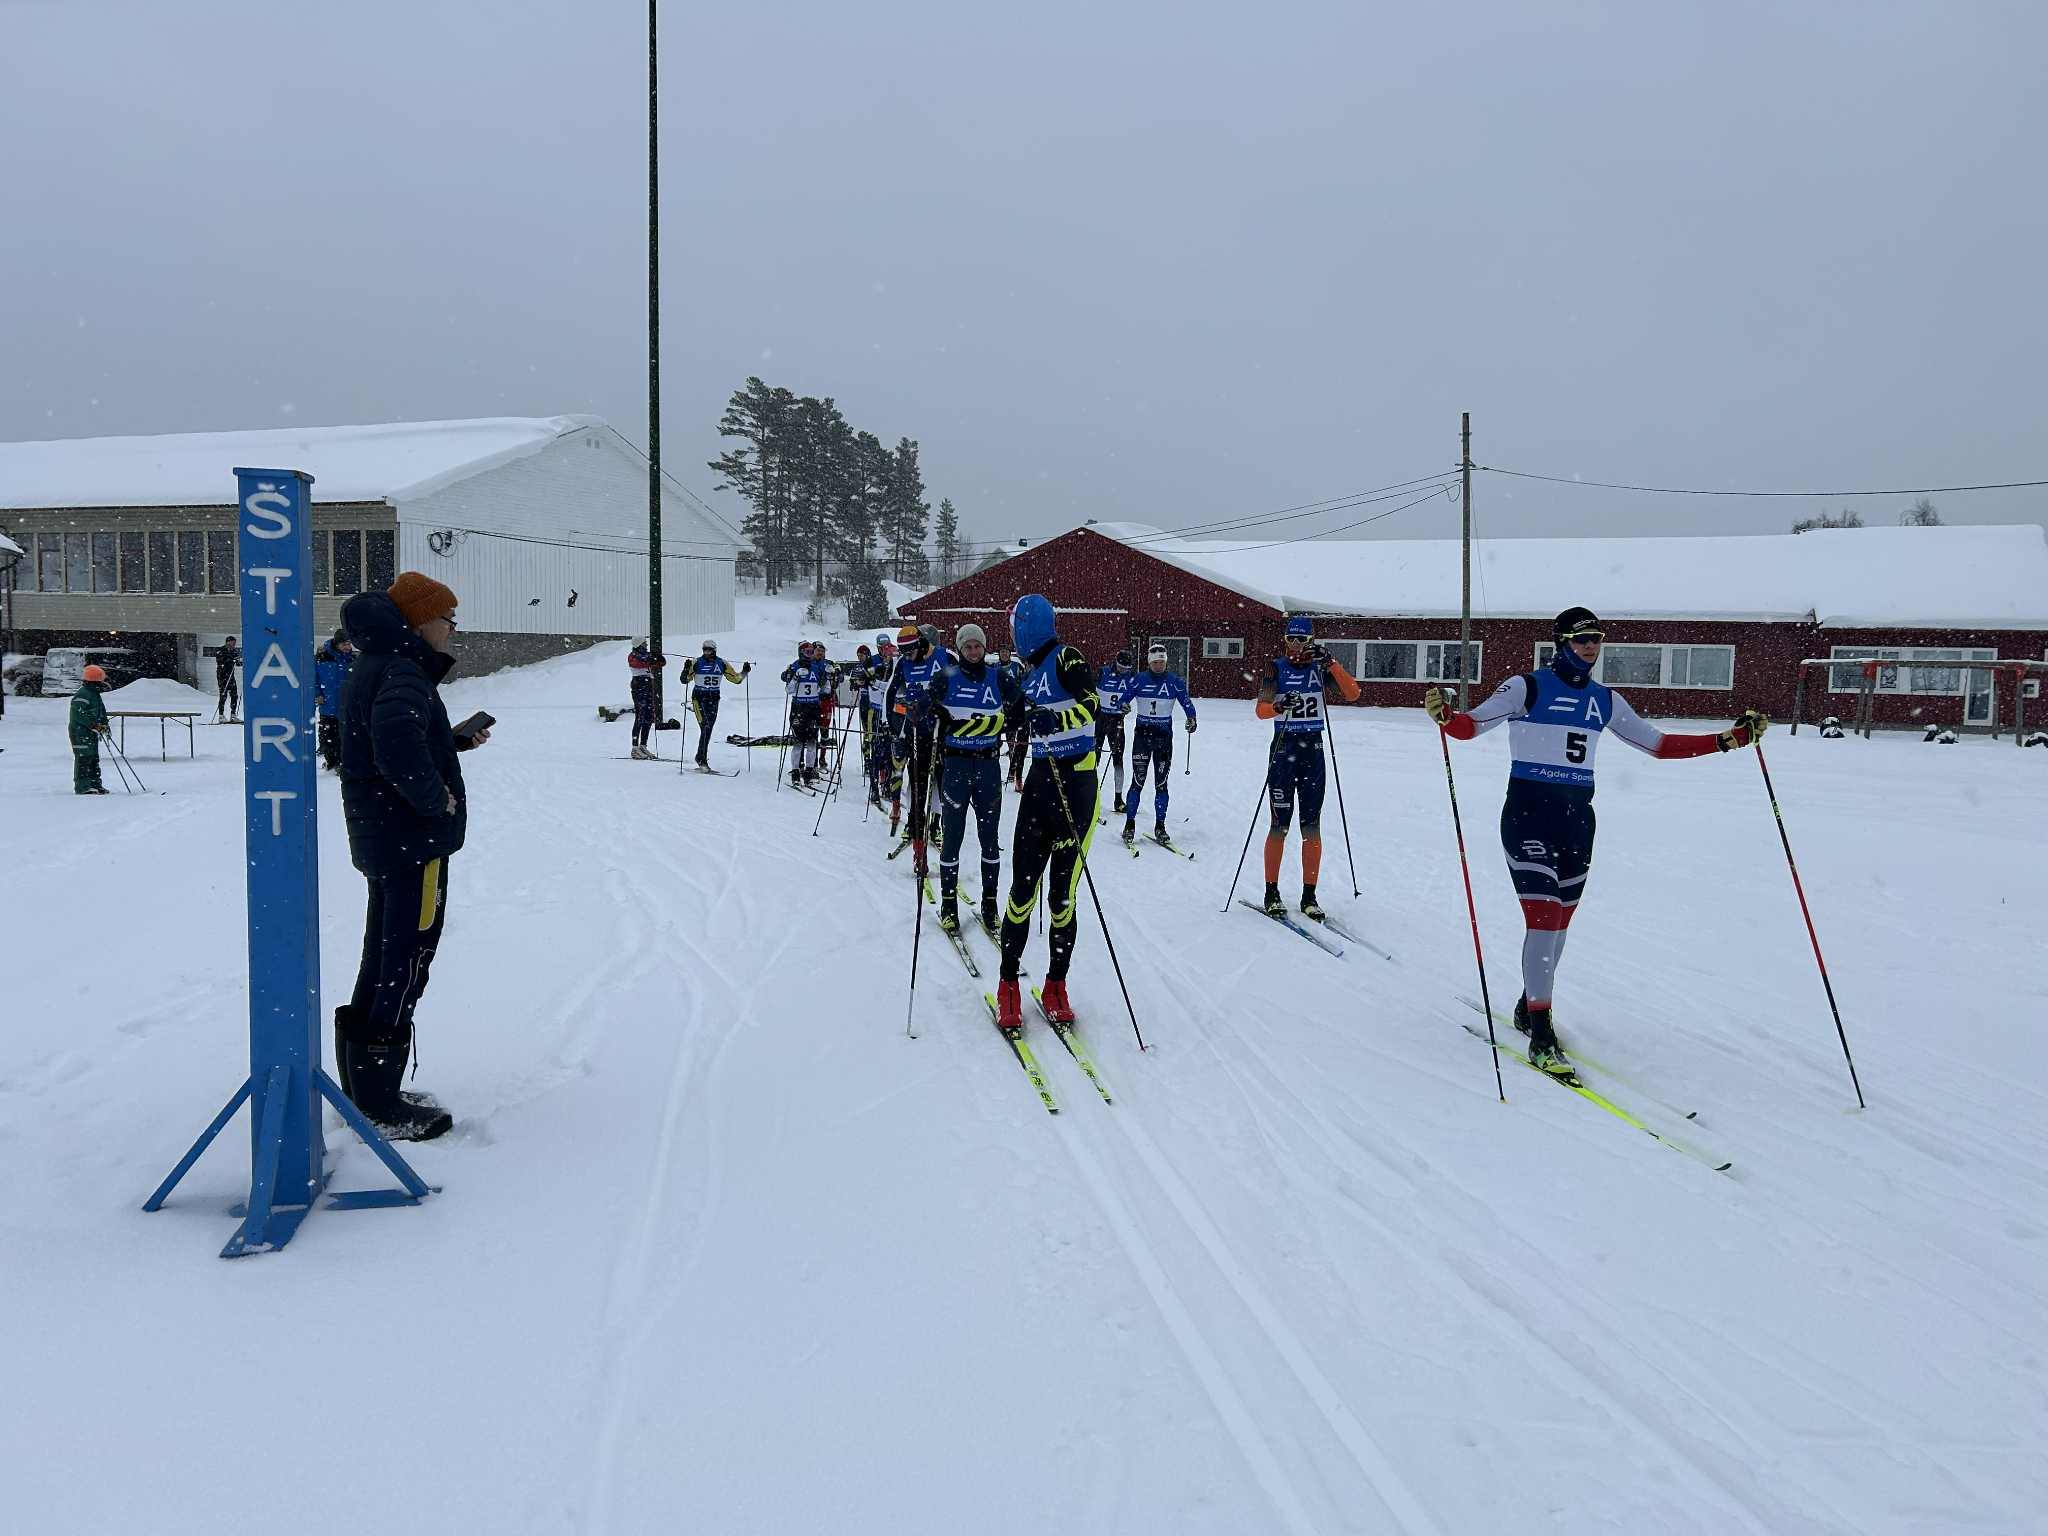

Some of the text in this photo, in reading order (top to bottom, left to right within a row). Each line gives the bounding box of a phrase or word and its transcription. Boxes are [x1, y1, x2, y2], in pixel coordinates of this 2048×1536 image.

[703, 676, 719, 686] 25
[1036, 672, 1052, 698] A
[1118, 680, 1127, 690] A
[1308, 669, 1322, 687] A
[804, 684, 812, 696] 3
[982, 686, 997, 704] A
[1158, 682, 1170, 696] A
[1149, 700, 1157, 715] 1
[1292, 697, 1318, 718] 22
[1584, 696, 1604, 725] A
[1565, 731, 1588, 764] 5
[1538, 767, 1569, 779] Agder
